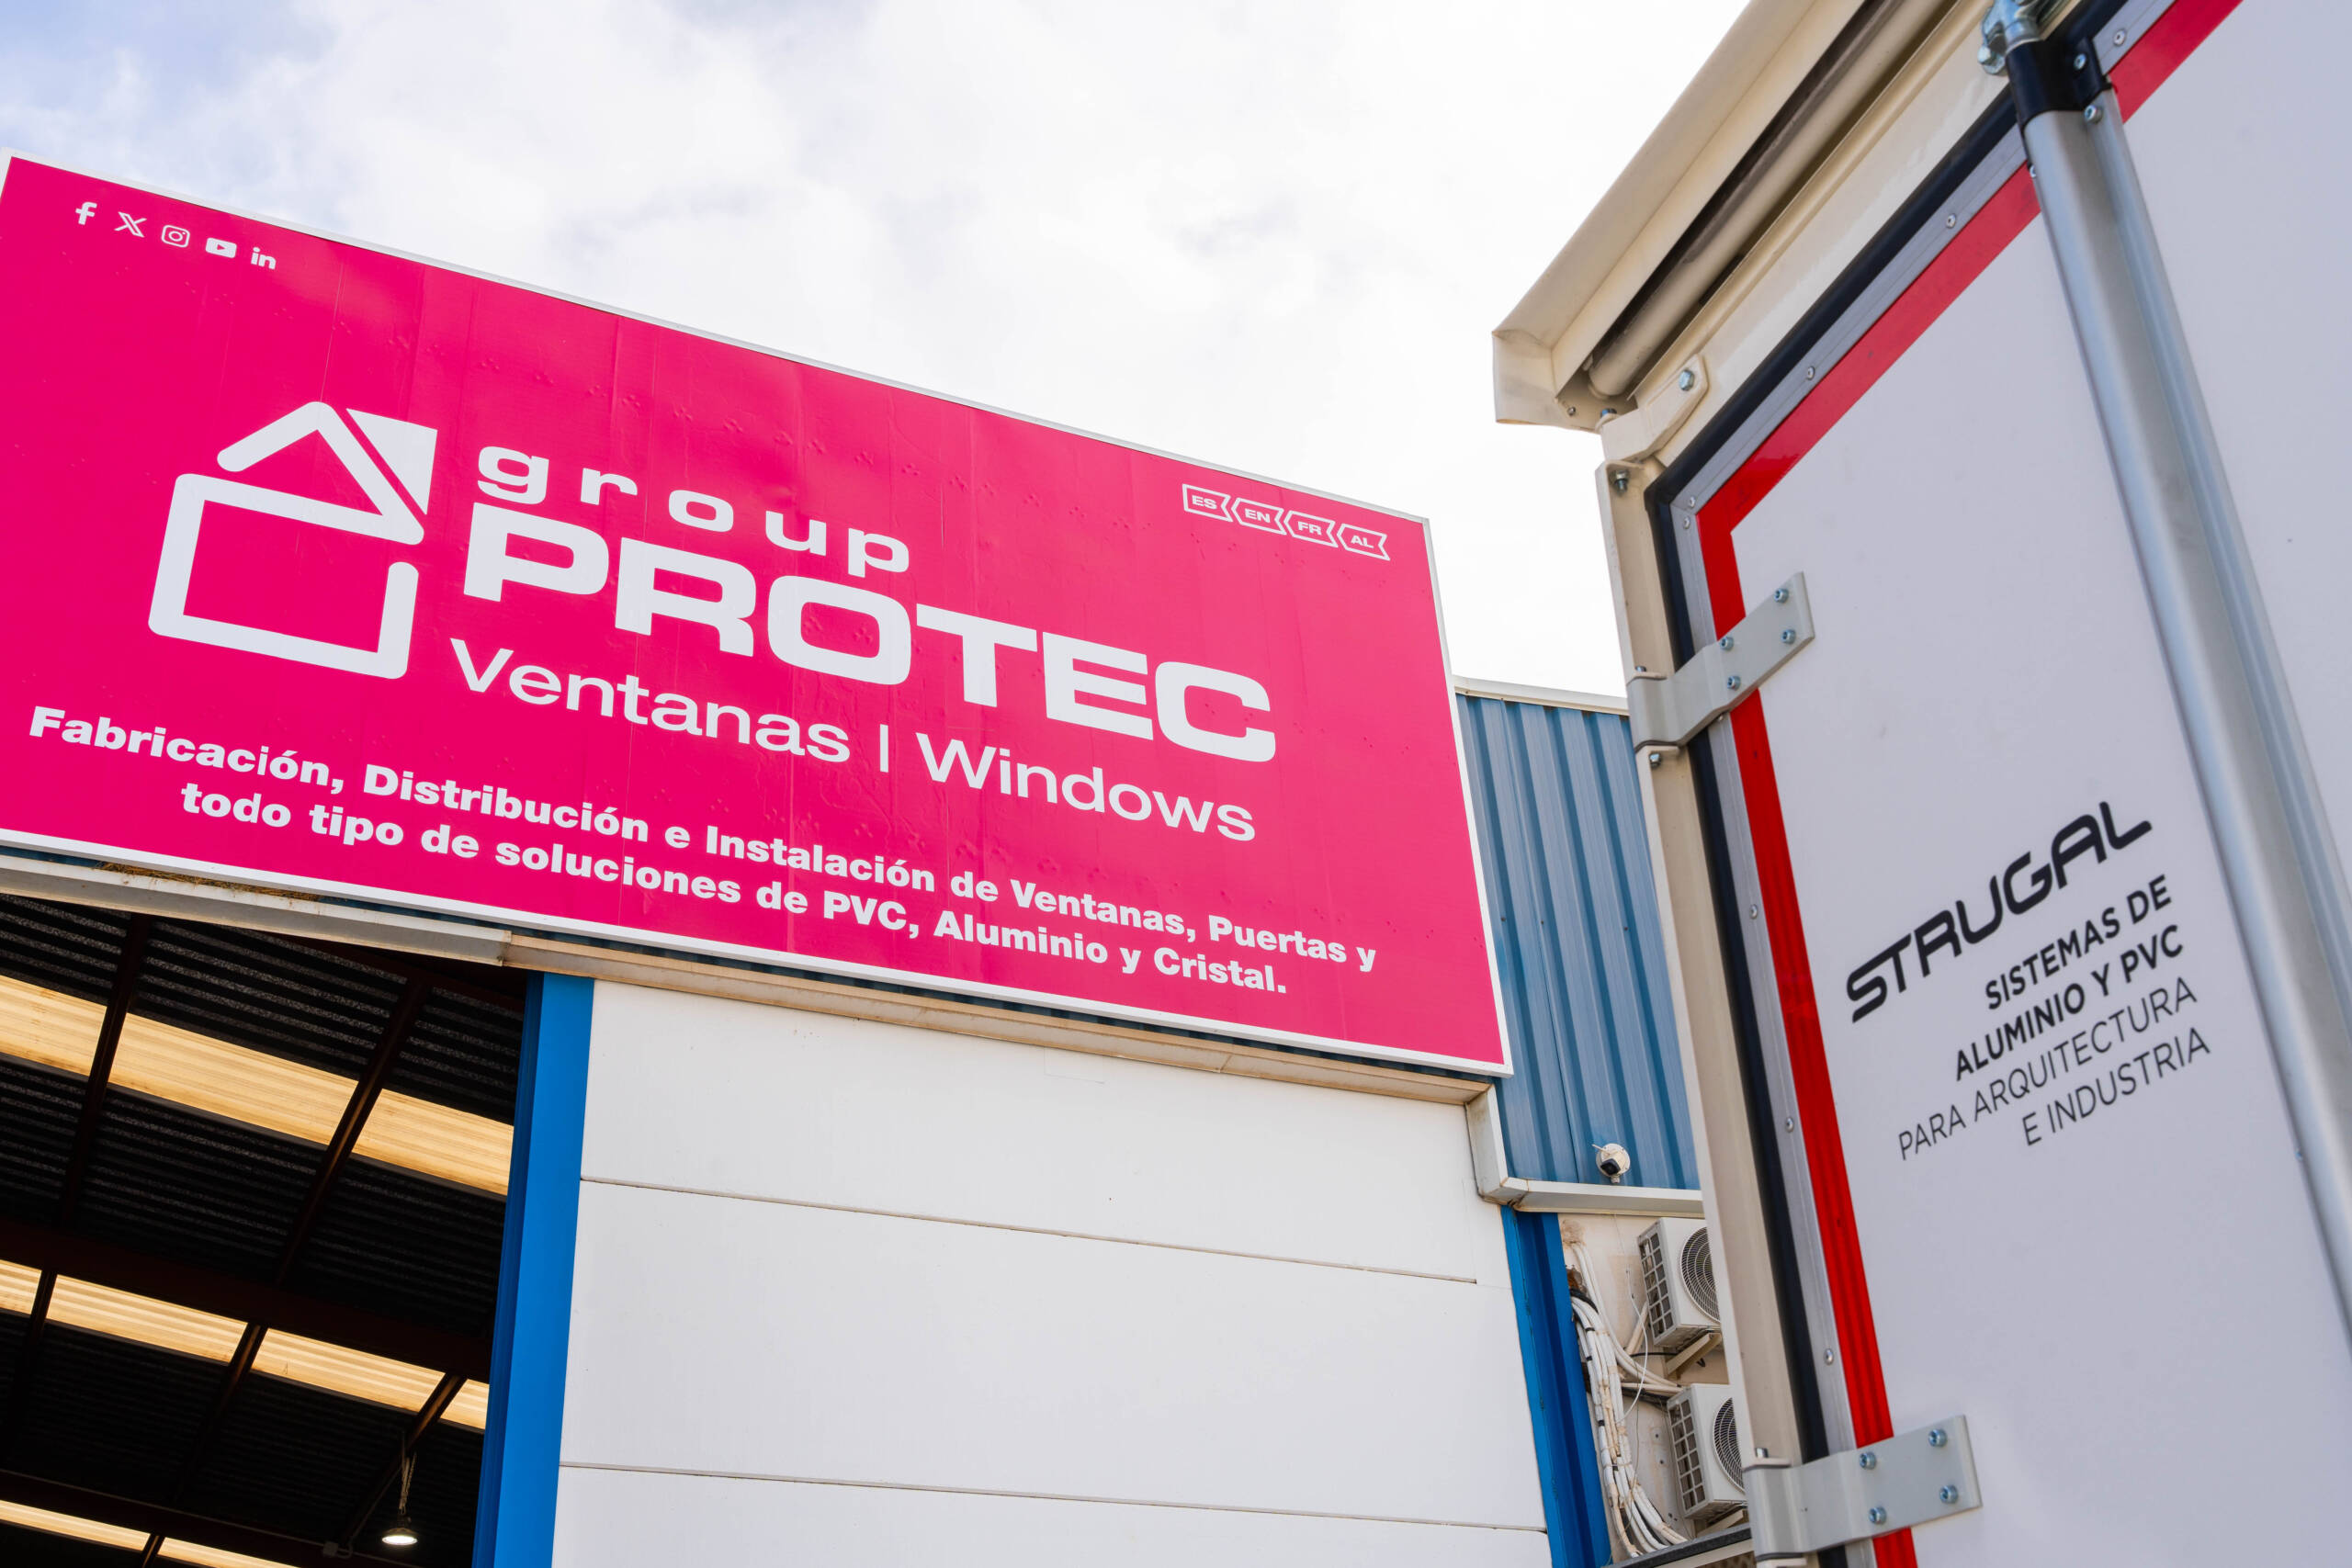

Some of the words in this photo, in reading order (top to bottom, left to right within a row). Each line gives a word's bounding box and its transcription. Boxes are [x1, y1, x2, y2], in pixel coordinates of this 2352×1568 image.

[477, 446, 910, 579] group
[1191, 494, 1218, 510] ES
[1244, 507, 1271, 524] EN
[1297, 521, 1322, 536] FR
[1350, 535, 1375, 549] AL
[463, 502, 1276, 762] PROTEC
[449, 637, 851, 762] Ventanas
[915, 732, 1257, 841] Windows
[29, 705, 344, 795] Fabricación,
[363, 763, 649, 842] Distribución
[664, 826, 691, 849] e
[706, 825, 935, 892] Instalación
[950, 870, 999, 902] de
[1010, 878, 1196, 943] Ventanas,
[1208, 914, 1348, 964] Puertas
[1356, 946, 1376, 973] y
[181, 783, 291, 828] todo
[309, 804, 404, 846] tipo
[421, 824, 480, 859] de
[494, 842, 741, 903] soluciones
[756, 881, 808, 914] de
[823, 890, 920, 939] PVC,
[933, 909, 1109, 964] Aluminio
[1119, 947, 1142, 975] y
[1153, 947, 1287, 994] Cristal.
[1846, 801, 2153, 1024] STRUGAL
[1956, 982, 2086, 1082] ALUMINIO
[2090, 962, 2110, 997] Y
[2120, 924, 2184, 984] PVC
[1984, 907, 2120, 1010] SISTEMAS
[2126, 874, 2172, 925] DE
[1898, 1104, 1967, 1161] PARA
[1973, 976, 2198, 1122] ARQUITECTURA
[2021, 1111, 2042, 1146] E
[2047, 1027, 2211, 1134] INDUSTRIA
